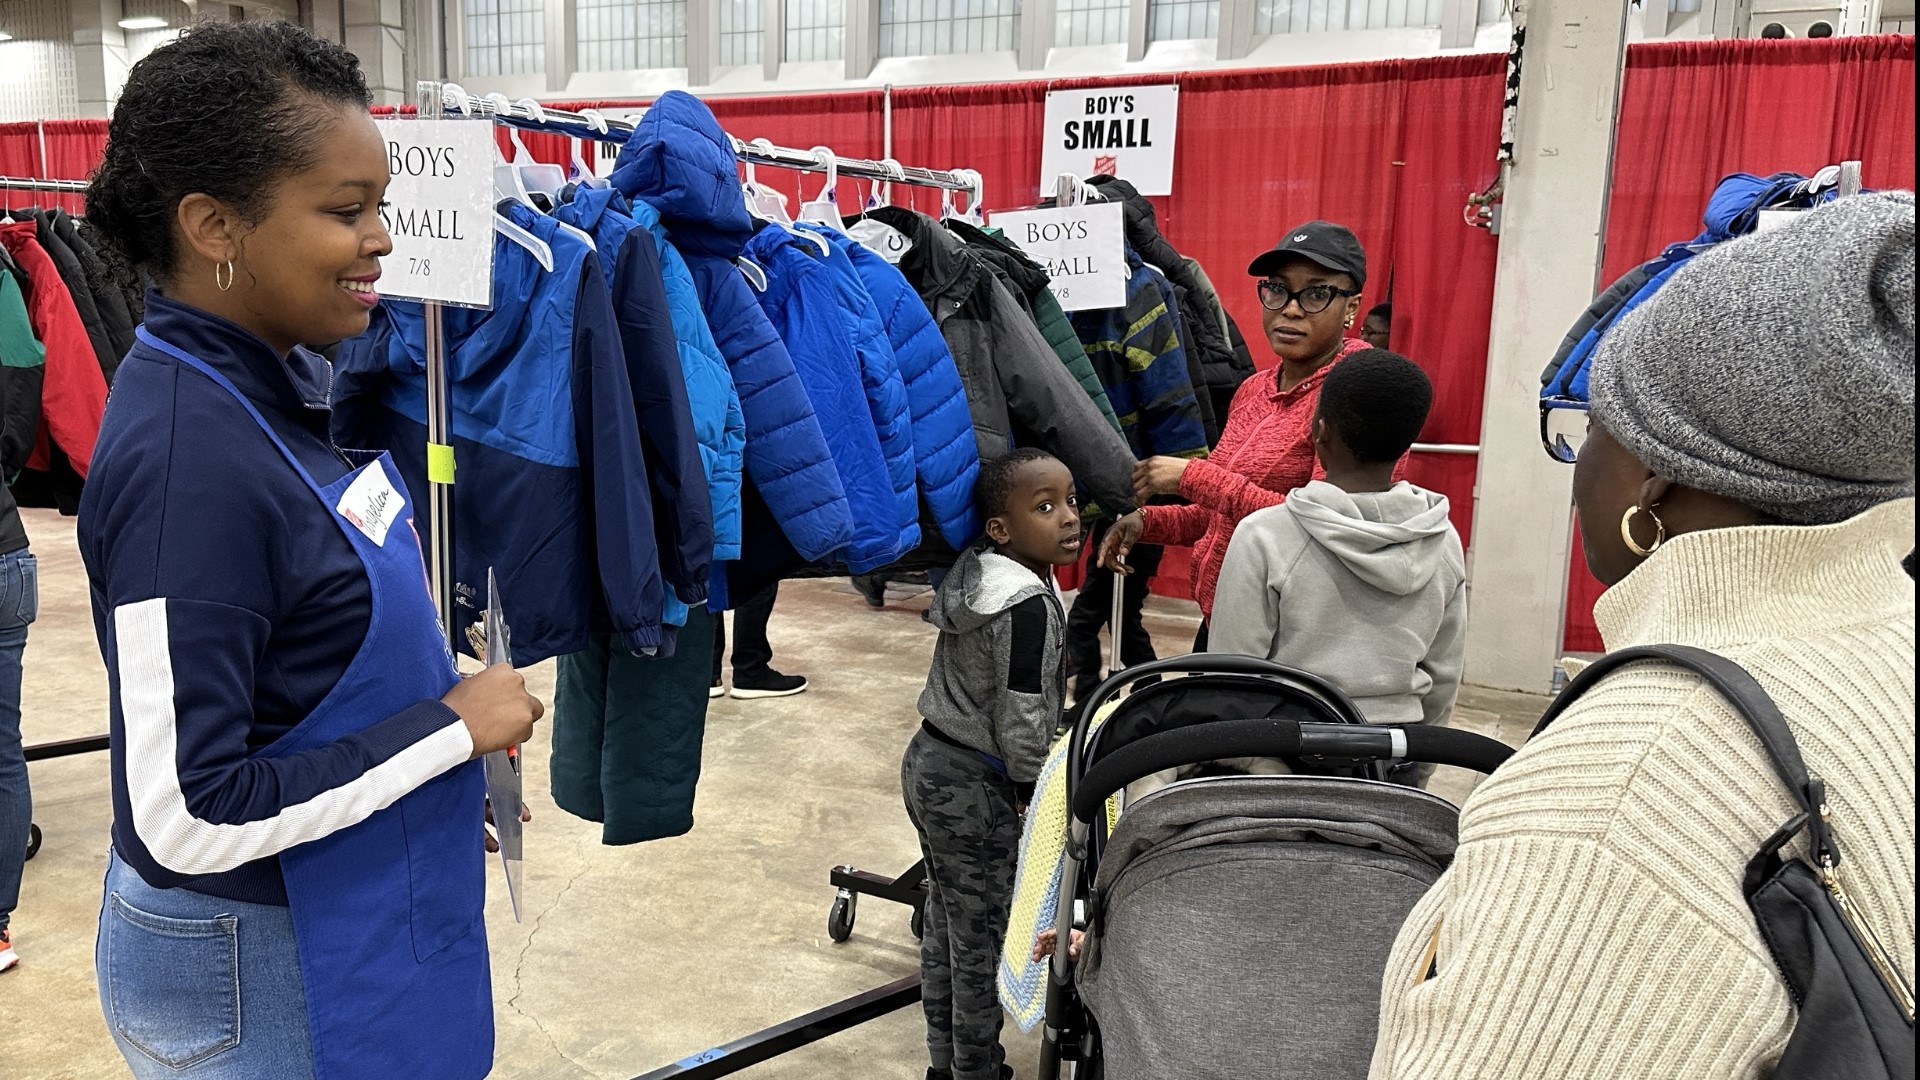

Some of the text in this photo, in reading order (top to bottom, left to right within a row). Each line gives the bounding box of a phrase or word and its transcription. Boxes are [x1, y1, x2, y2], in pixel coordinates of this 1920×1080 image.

[1085, 95, 1134, 115] BOY'S
[1064, 118, 1152, 150] SMALL
[388, 141, 455, 177] BOYS
[381, 203, 464, 240] SMALL
[1026, 220, 1088, 243] BOYS
[409, 258, 431, 276] 7/8
